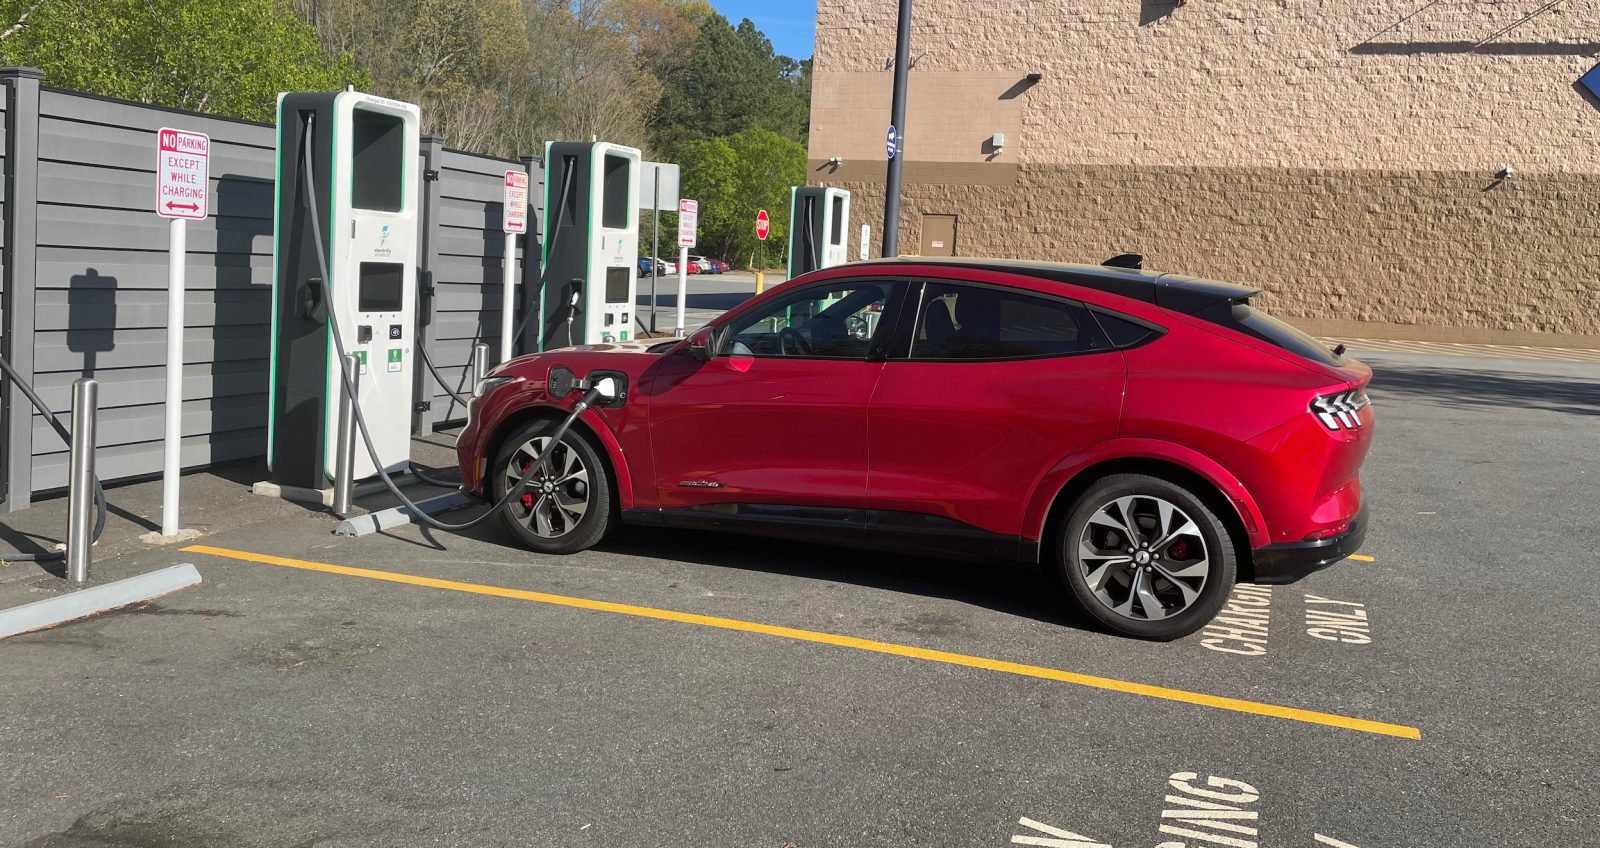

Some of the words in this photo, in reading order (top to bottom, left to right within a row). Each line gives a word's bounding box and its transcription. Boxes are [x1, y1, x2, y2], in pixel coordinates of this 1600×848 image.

[162, 133, 176, 148] NO
[178, 136, 206, 151] PARKING
[168, 156, 200, 171] EXCEPT
[170, 172, 196, 184] WHILE
[162, 185, 203, 199] CHARGING
[757, 219, 769, 231] STOP
[1304, 594, 1372, 644] ONLY
